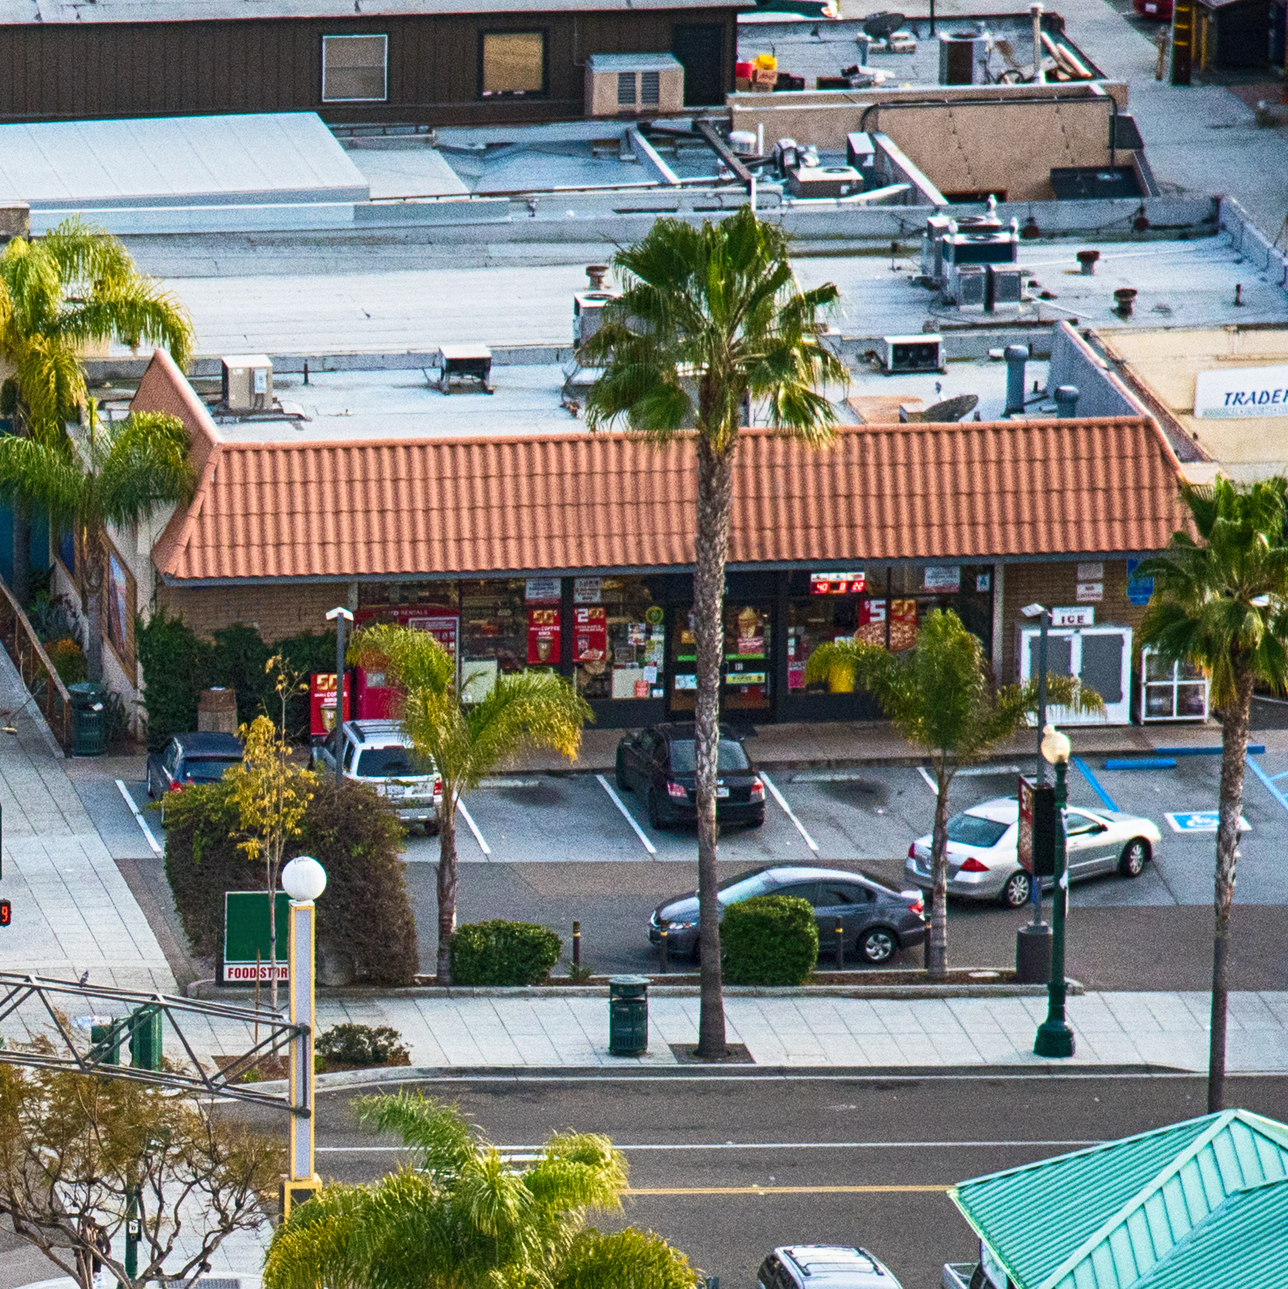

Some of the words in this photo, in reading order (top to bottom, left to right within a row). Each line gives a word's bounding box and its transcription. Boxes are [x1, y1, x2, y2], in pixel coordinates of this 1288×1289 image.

[1061, 615, 1085, 624] ICE
[1, 905, 9, 923] 9
[227, 967, 257, 978] FOOD
